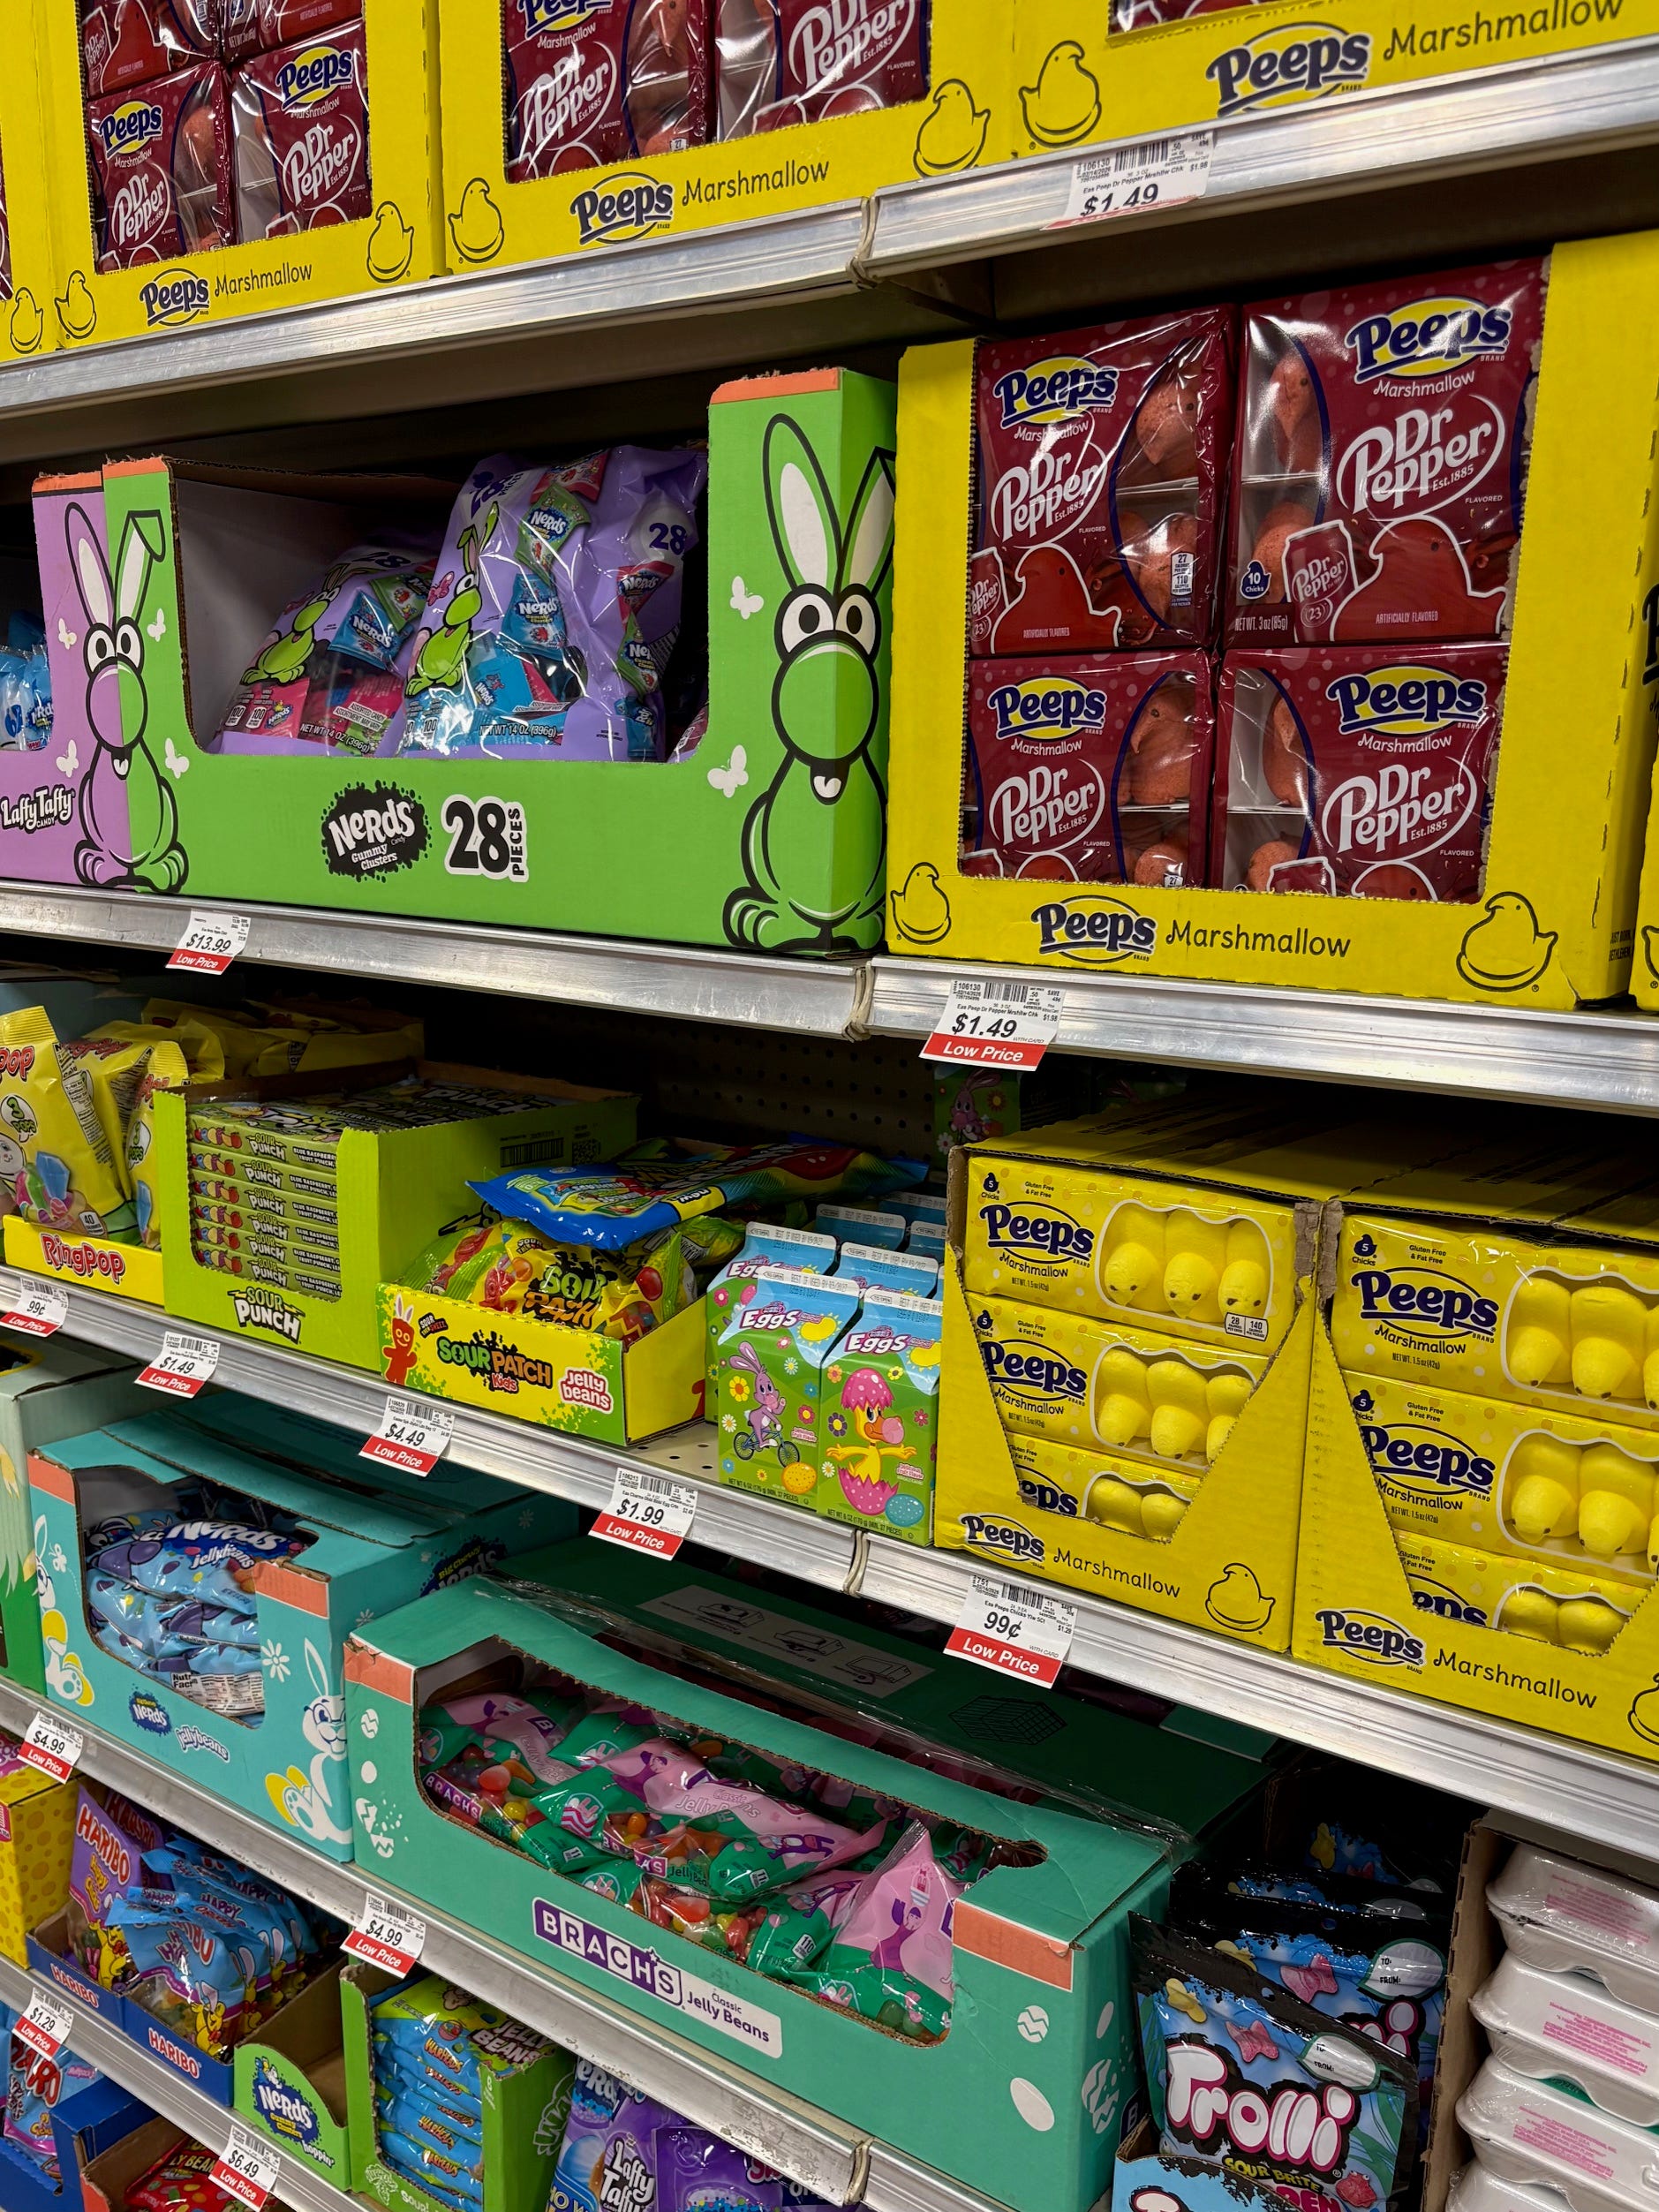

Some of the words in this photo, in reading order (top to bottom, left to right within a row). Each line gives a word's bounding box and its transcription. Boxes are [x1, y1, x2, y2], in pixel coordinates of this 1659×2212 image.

[537, 23, 596, 49] Marshmallow
[803, 4, 898, 85] Pepper
[863, 34, 893, 62] Est.1885
[1207, 34, 1371, 102] Peeps
[1384, 0, 1624, 60] Marshmallow
[277, 49, 352, 97] Peeps
[529, 68, 610, 147] Pepper
[100, 105, 162, 151] Peeps
[305, 123, 334, 163] Dr
[114, 147, 153, 168] Marshmallow
[283, 132, 354, 206] Pepper
[126, 175, 149, 209] Dr
[571, 184, 674, 235] Peeps
[682, 160, 829, 206] Marshmallow
[1081, 184, 1158, 216] $1.49
[112, 182, 166, 245] Pepper
[140, 277, 209, 320] Peeps
[215, 263, 313, 298] Marshmallow
[1348, 307, 1511, 370] Peeps
[996, 368, 1118, 417] Peeps
[1373, 371, 1474, 397] Marshmallow
[1394, 407, 1454, 455] Dr
[1029, 452, 1072, 492] Dr
[1352, 422, 1491, 514] Pepper
[1432, 464, 1474, 492] Est.1885
[1001, 466, 1101, 540] Pepper
[1465, 494, 1503, 504] FLAVORED
[649, 522, 687, 555] 28
[1247, 572, 1261, 585] 10
[1294, 560, 1344, 602] Pepper
[1307, 555, 1330, 580] Dr
[989, 686, 1107, 732] Peeps
[1328, 674, 1486, 723] Peeps
[1011, 738, 1082, 756] Marshmallow
[1358, 733, 1452, 754] Marshmallow
[1029, 766, 1068, 803] Dr
[1379, 764, 1430, 801] Dr
[1, 797, 37, 830] Laffy
[35, 786, 74, 827] Taffy
[1003, 776, 1095, 846] Pepper
[1337, 775, 1465, 854] Pepper
[444, 800, 510, 874] 28
[509, 808, 524, 877] PIECES
[351, 844, 388, 864] Gummy
[360, 851, 397, 872] Clusters
[185, 932, 232, 955] $13.99
[1031, 904, 1156, 948] Peeps
[1165, 924, 1351, 959] Marshmallow
[177, 953, 200, 968] Low
[198, 956, 219, 970] Price
[952, 1013, 1017, 1038] $1.49
[943, 1041, 979, 1056] Low
[981, 1046, 1024, 1061] Price
[1024, 1181, 1042, 1191] Gluten
[980, 1205, 1095, 1256] Peeps
[999, 1253, 1069, 1278] Marshmallow
[1408, 1243, 1430, 1256] Gluten
[1431, 1248, 1447, 1257] Free
[1417, 1254, 1429, 1263] Fat
[1429, 1256, 1444, 1265] Free
[26, 1301, 45, 1317] 99¢
[246, 1287, 284, 1312] SOUR
[1351, 1270, 1499, 1328] Peeps
[9, 1317, 26, 1326] Low
[25, 1320, 46, 1332] Price
[235, 1297, 300, 1345] PUNCH
[1017, 1320, 1035, 1330] Gluten
[1035, 1323, 1046, 1332] Free
[1249, 1320, 1263, 1329] 140
[1375, 1325, 1467, 1355] Marshmallow
[159, 1356, 195, 1374] $1.49
[438, 1338, 492, 1370] SOUR
[492, 1348, 553, 1387] PATCH
[982, 1342, 1087, 1393] Peeps
[148, 1373, 170, 1385] Low
[170, 1378, 191, 1391] Price
[491, 1372, 518, 1393] Kids
[562, 1385, 611, 1411] beans
[994, 1388, 1065, 1415] Marshmallow
[385, 1423, 425, 1446] $4.49
[374, 1444, 396, 1458] Low
[396, 1451, 423, 1467] Price
[1362, 1429, 1496, 1489] Peeps
[1376, 1477, 1463, 1512] Marshmallow
[616, 1499, 664, 1525] $1.99
[606, 1521, 633, 1538] Low
[633, 1530, 665, 1549] Price
[191, 1544, 255, 1568] jellybeans
[961, 1514, 1045, 1561] Peeps
[1053, 1547, 1180, 1599] Marshmallow
[984, 1612, 1022, 1641] 99¢
[962, 1637, 998, 1659] Low
[998, 1650, 1040, 1674] Price
[1044, 1650, 1059, 1658] CARD
[1316, 1610, 1424, 1663] Peeps
[1434, 1648, 1598, 1709] Marshmallow
[32, 1730, 65, 1754] $4.99
[177, 1728, 228, 1761] jellybeans
[27, 1748, 46, 1764] Low
[44, 1757, 63, 1774] Price
[76, 1804, 131, 1884] HARIBO
[365, 1920, 403, 1947] $4.99
[355, 1936, 377, 1956] Low
[377, 1945, 402, 1967] Price
[50, 1964, 100, 2008] HARIBO
[29, 2006, 56, 2033] $1.29
[688, 1991, 720, 2019] Jelly
[723, 2008, 769, 2042] Beans
[712, 1993, 743, 2014] Classic
[20, 2023, 36, 2038] Low
[34, 2033, 52, 2051] Price
[148, 2027, 200, 2079] HARIBO
[1167, 2044, 1354, 2168] Trolli
[228, 2153, 260, 2178] $6.49
[615, 2140, 655, 2200] Laffy
[220, 2169, 238, 2185] Low
[236, 2179, 257, 2201] Price
